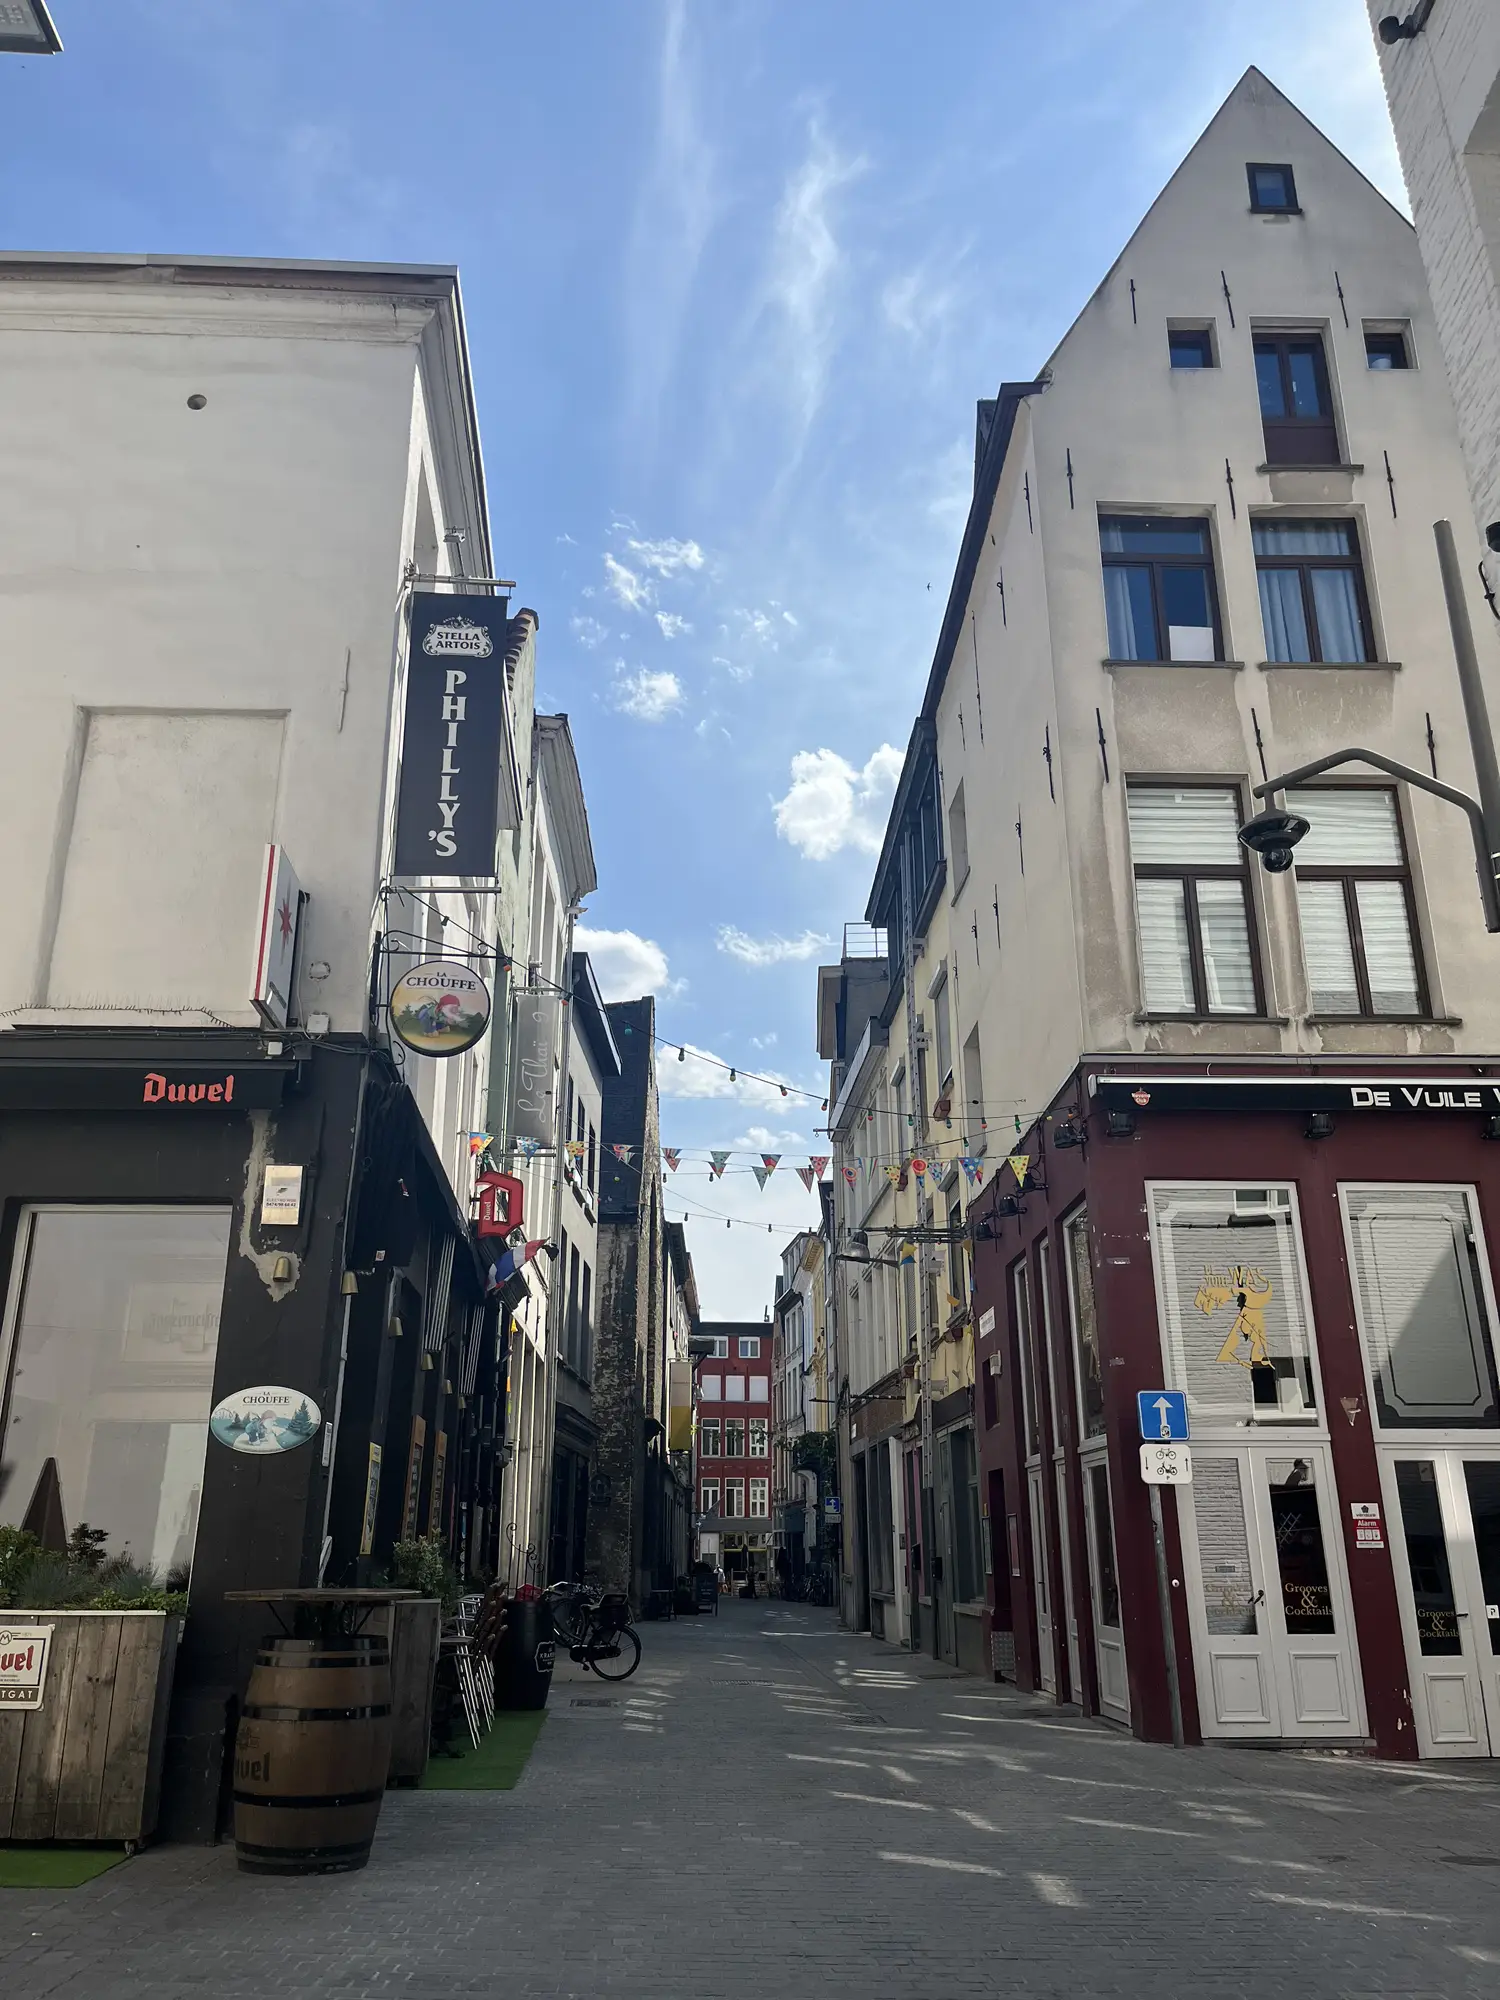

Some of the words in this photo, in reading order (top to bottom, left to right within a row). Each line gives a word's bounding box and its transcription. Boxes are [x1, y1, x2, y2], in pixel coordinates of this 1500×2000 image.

[437, 632, 480, 641] STELLA
[436, 641, 481, 650] ARTOIS
[428, 669, 467, 857] PHILLY'S
[406, 977, 476, 990] CHOUFFE
[143, 1073, 235, 1103] Duvel
[243, 1396, 290, 1404] CHOUFFE
[1358, 1519, 1377, 1527] Alarm
[1285, 1583, 1328, 1593] Grooves
[1301, 1589, 1318, 1608] &
[1285, 1605, 1333, 1616] Cocktails
[1418, 1608, 1455, 1618] Grooves
[1431, 1616, 1446, 1630] &
[1419, 1629, 1459, 1638] Cocktails
